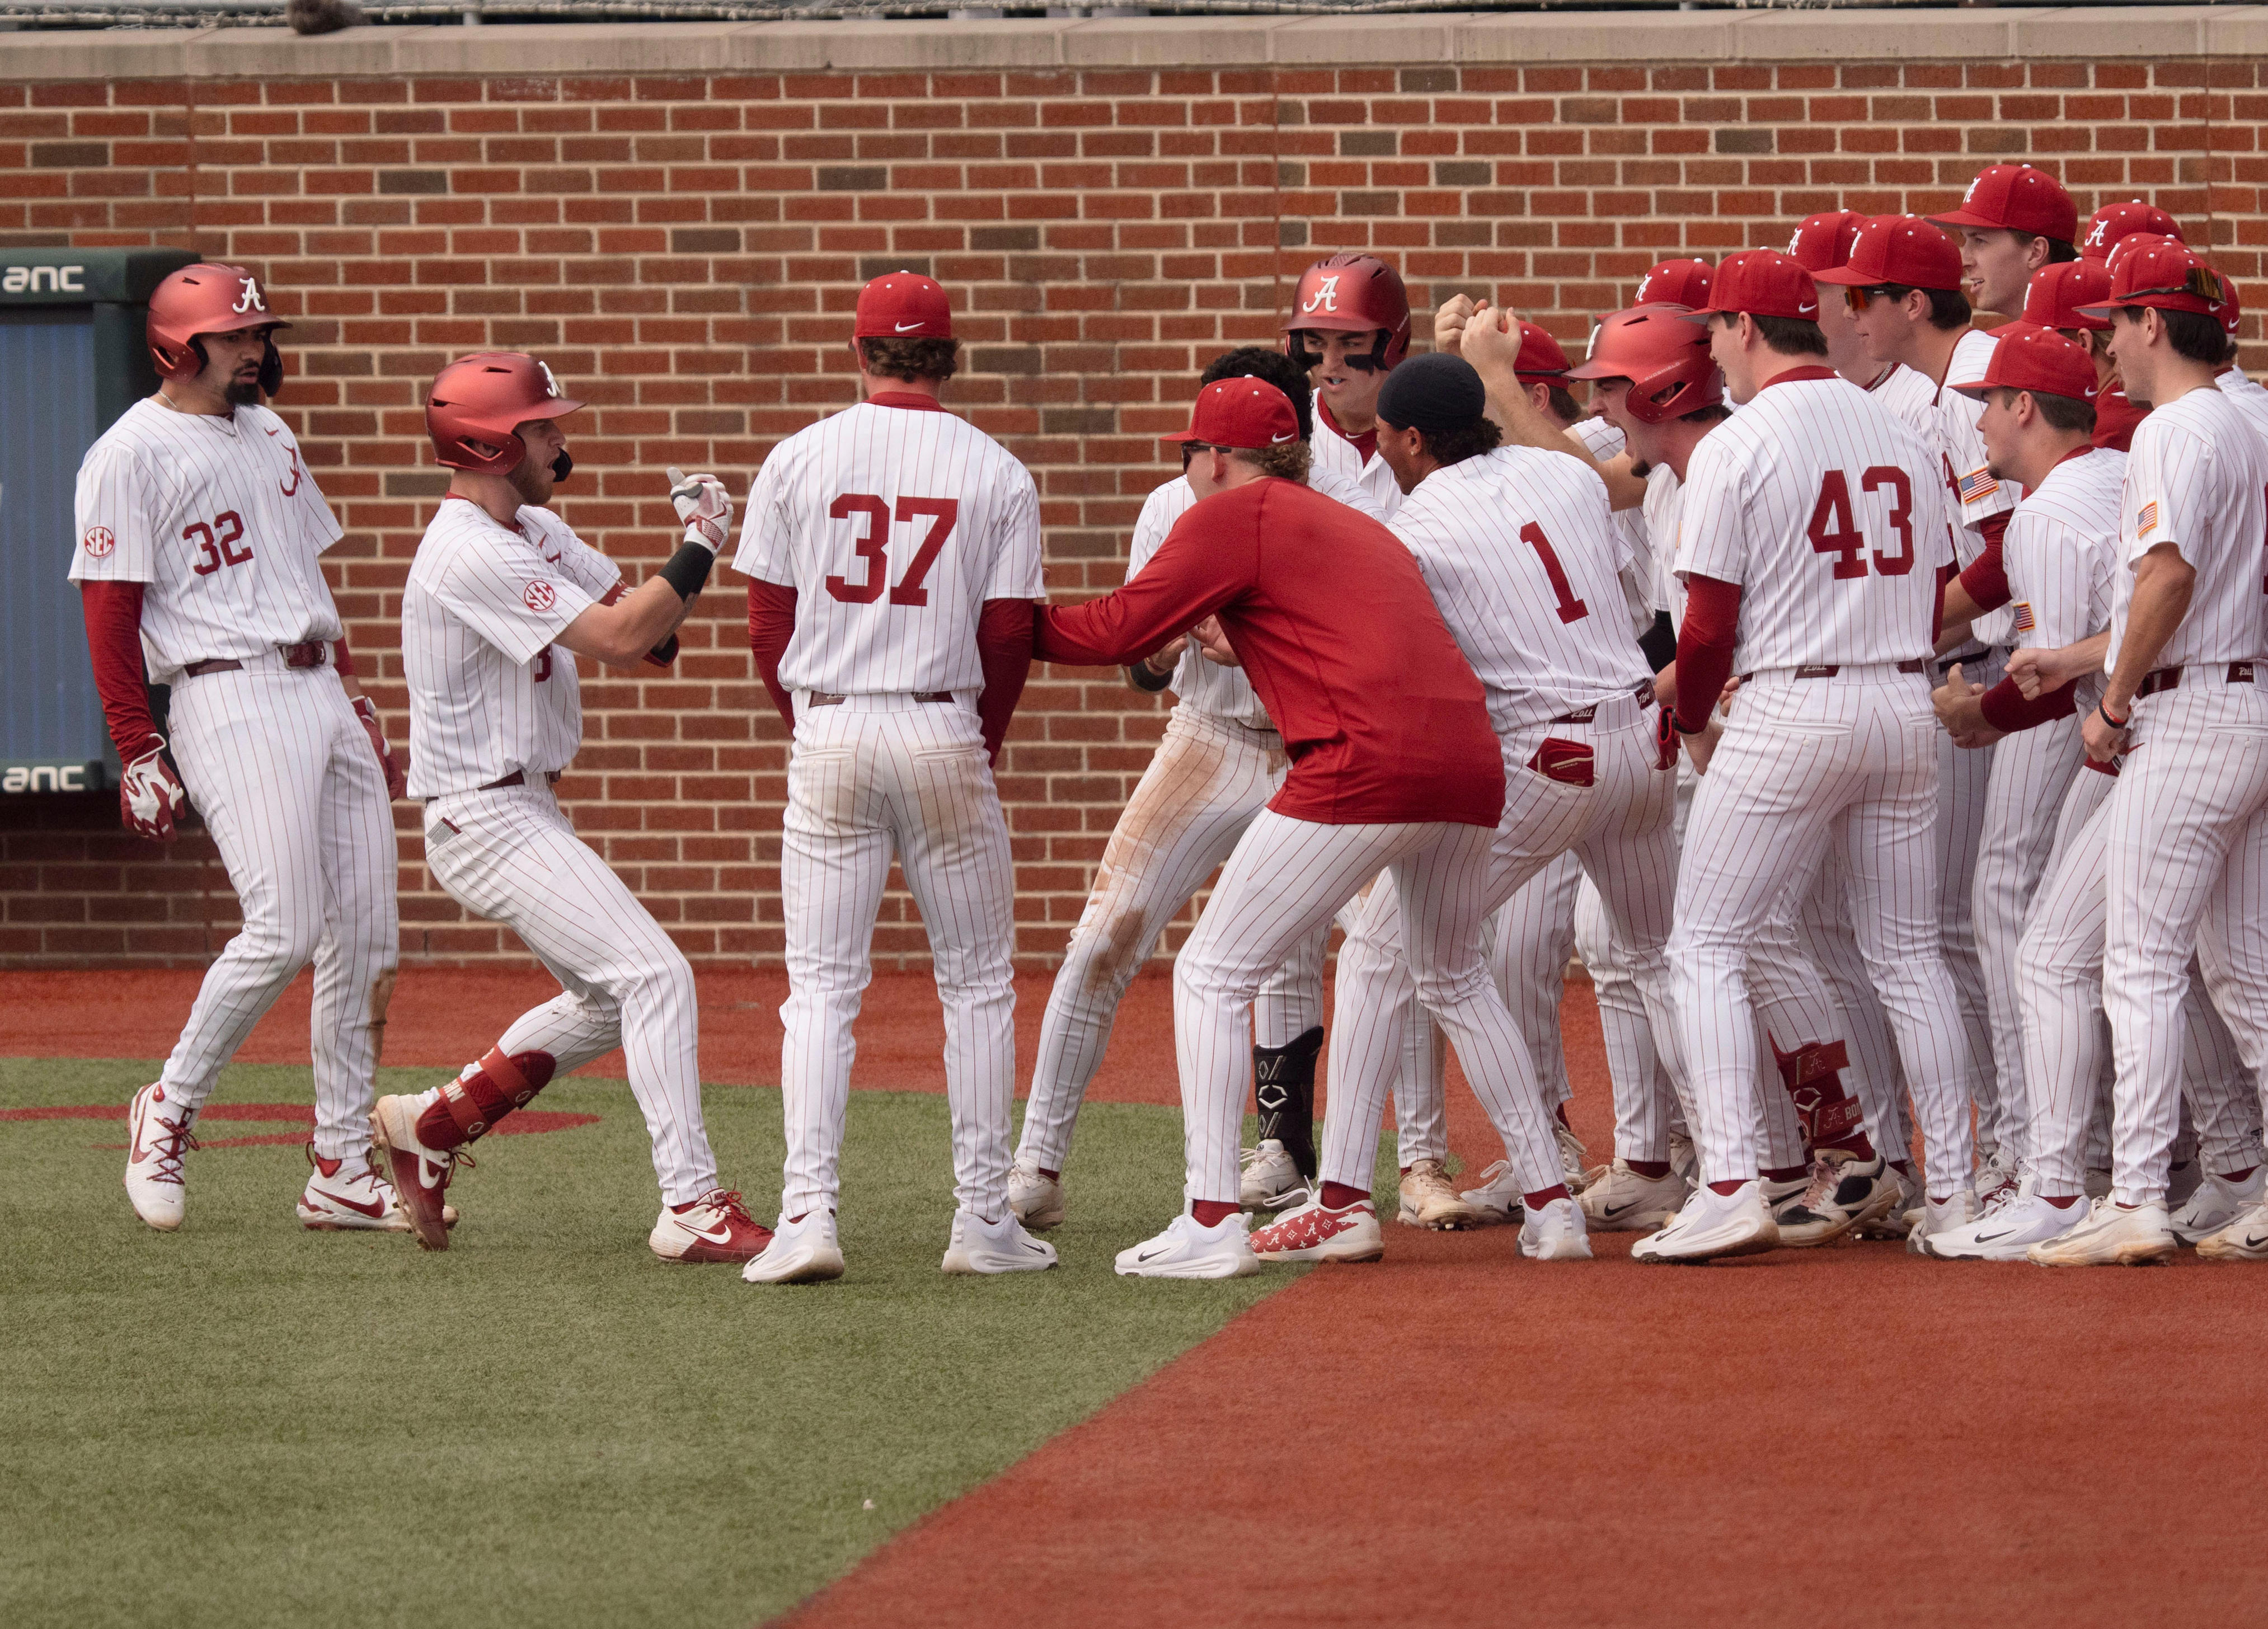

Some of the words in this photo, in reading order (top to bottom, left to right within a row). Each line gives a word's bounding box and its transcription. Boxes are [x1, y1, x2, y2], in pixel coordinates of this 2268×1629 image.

[2084, 219, 2109, 246] A
[3, 266, 84, 292] anc
[232, 277, 265, 313] A
[1302, 275, 1340, 312] A
[1807, 466, 1914, 580] 43
[86, 527, 113, 556] SEC
[183, 510, 253, 576] 32
[825, 494, 959, 607] 37
[1520, 521, 1589, 625] 1
[525, 581, 554, 609] SEC
[2239, 666, 2253, 676] ROLL
[1571, 708, 1594, 719] ROLL
[3, 766, 84, 792] anc
[1266, 1232, 1280, 1246] A
[1304, 1221, 1317, 1237] A
